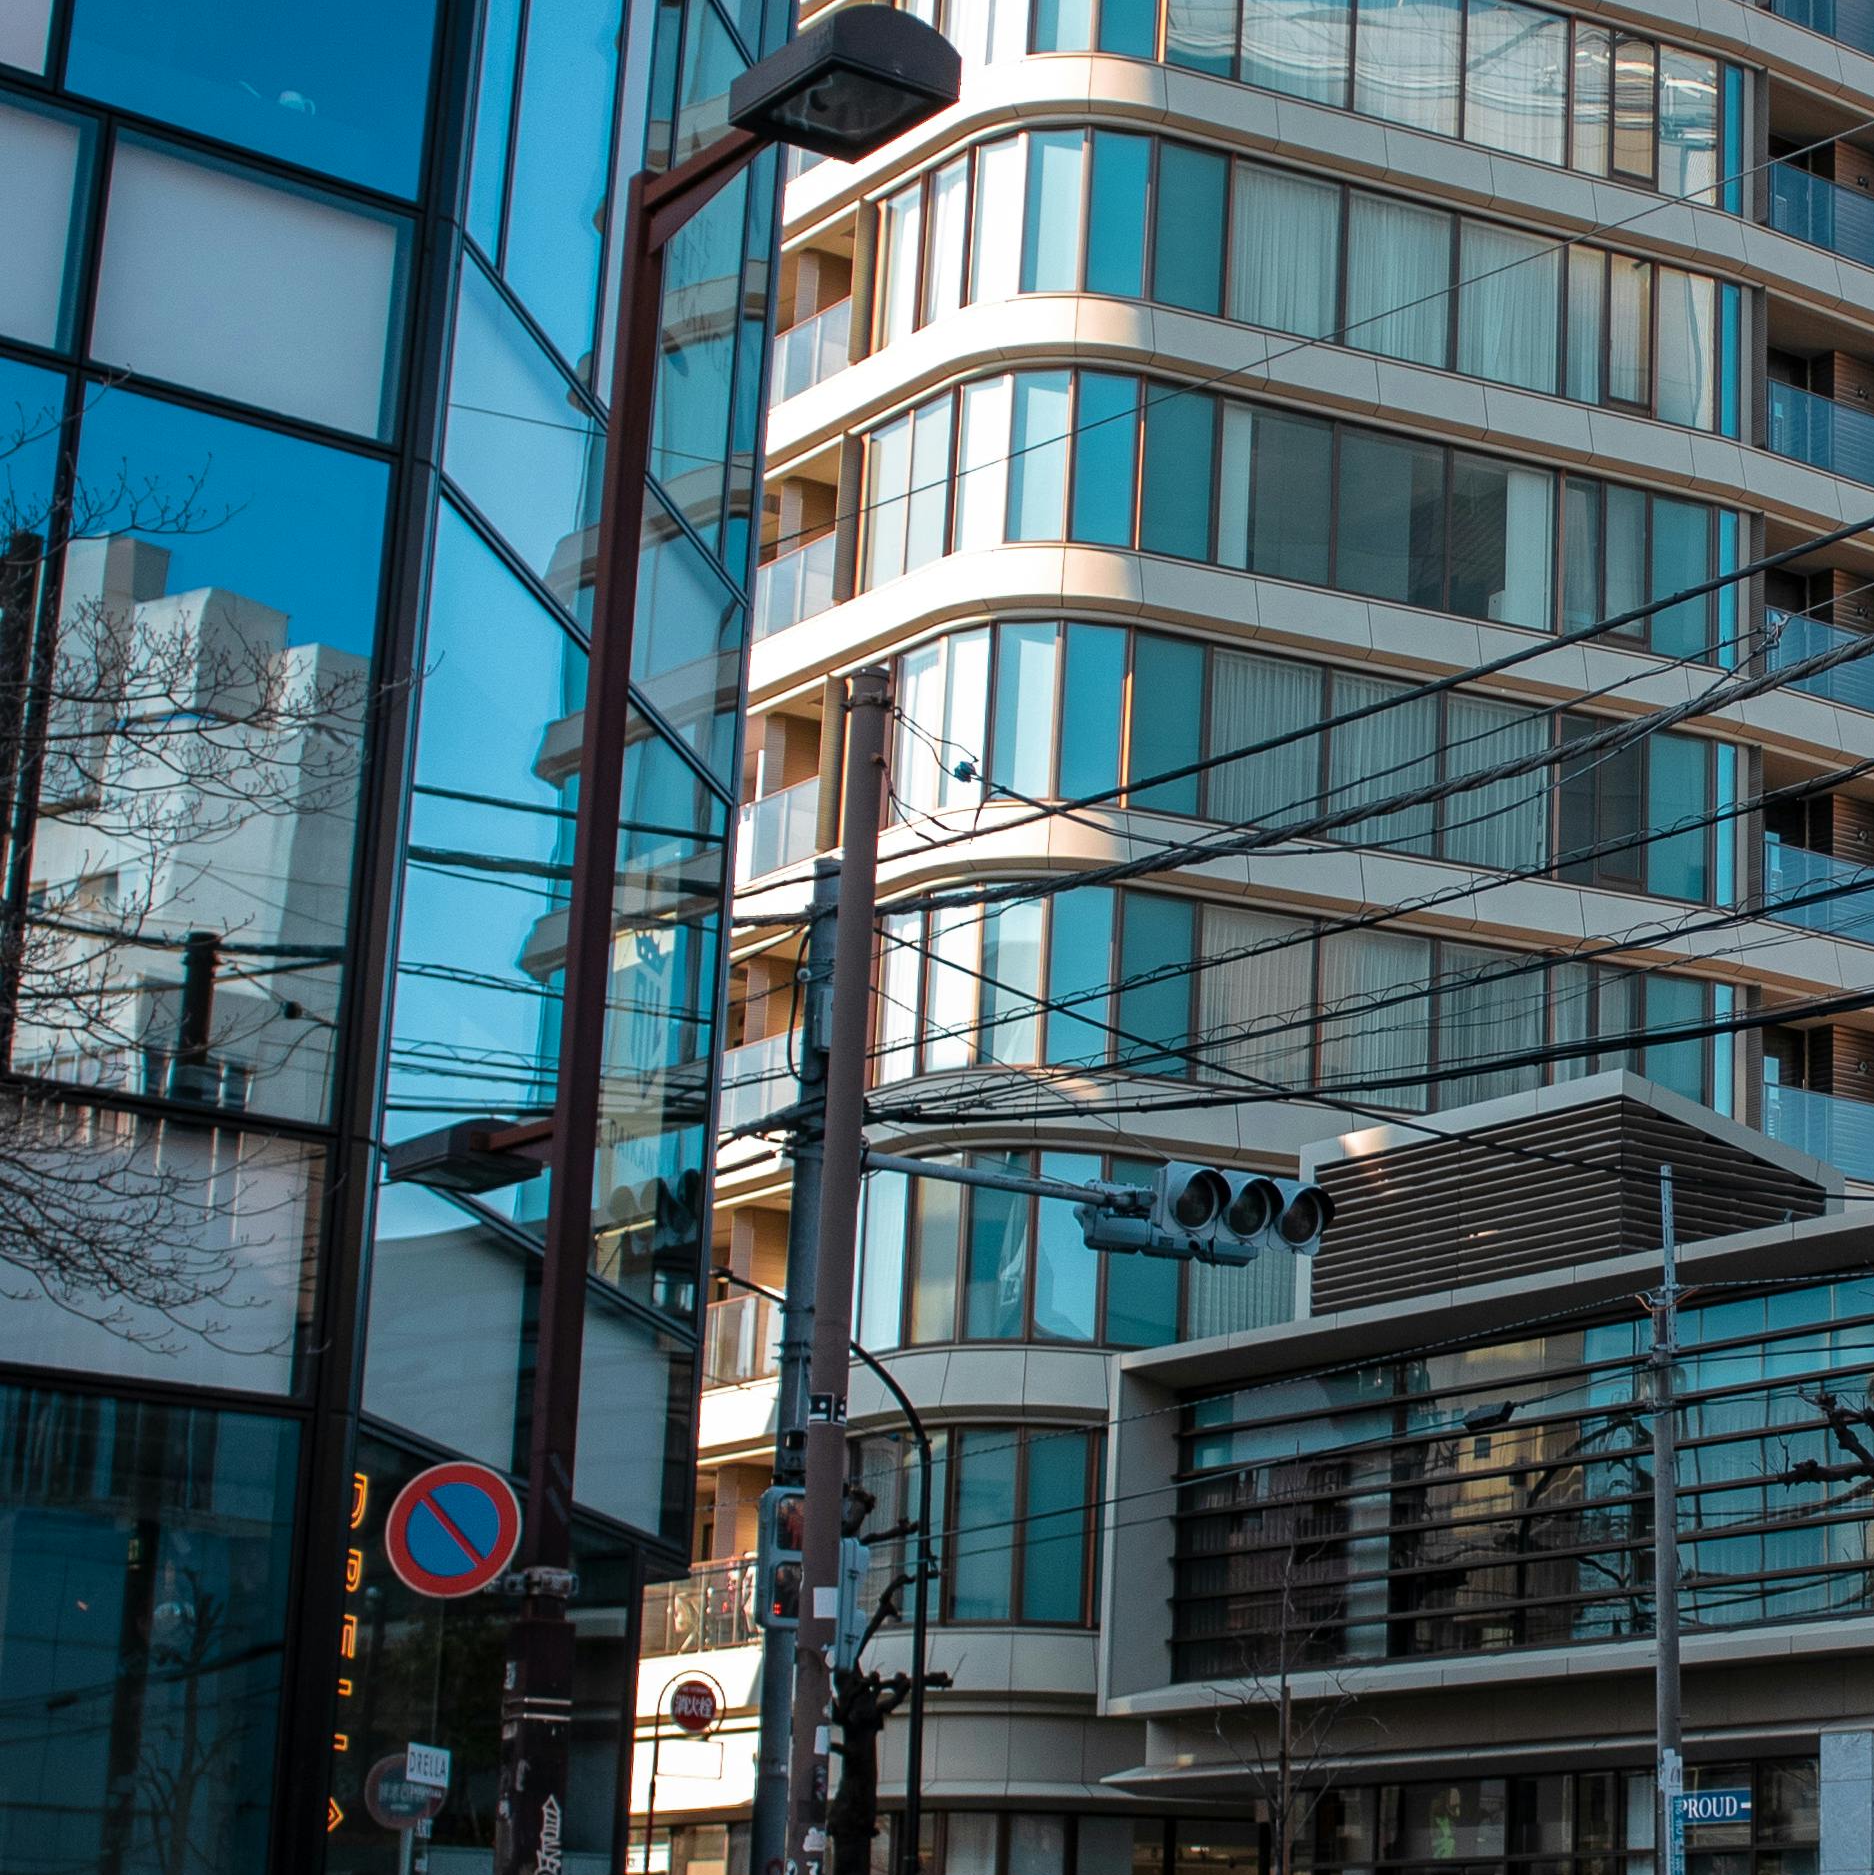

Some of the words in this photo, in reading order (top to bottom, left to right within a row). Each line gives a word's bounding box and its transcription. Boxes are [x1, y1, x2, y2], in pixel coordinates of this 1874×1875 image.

[674, 1693, 714, 1719] 消火栓
[409, 1751, 446, 1777] DRELLA
